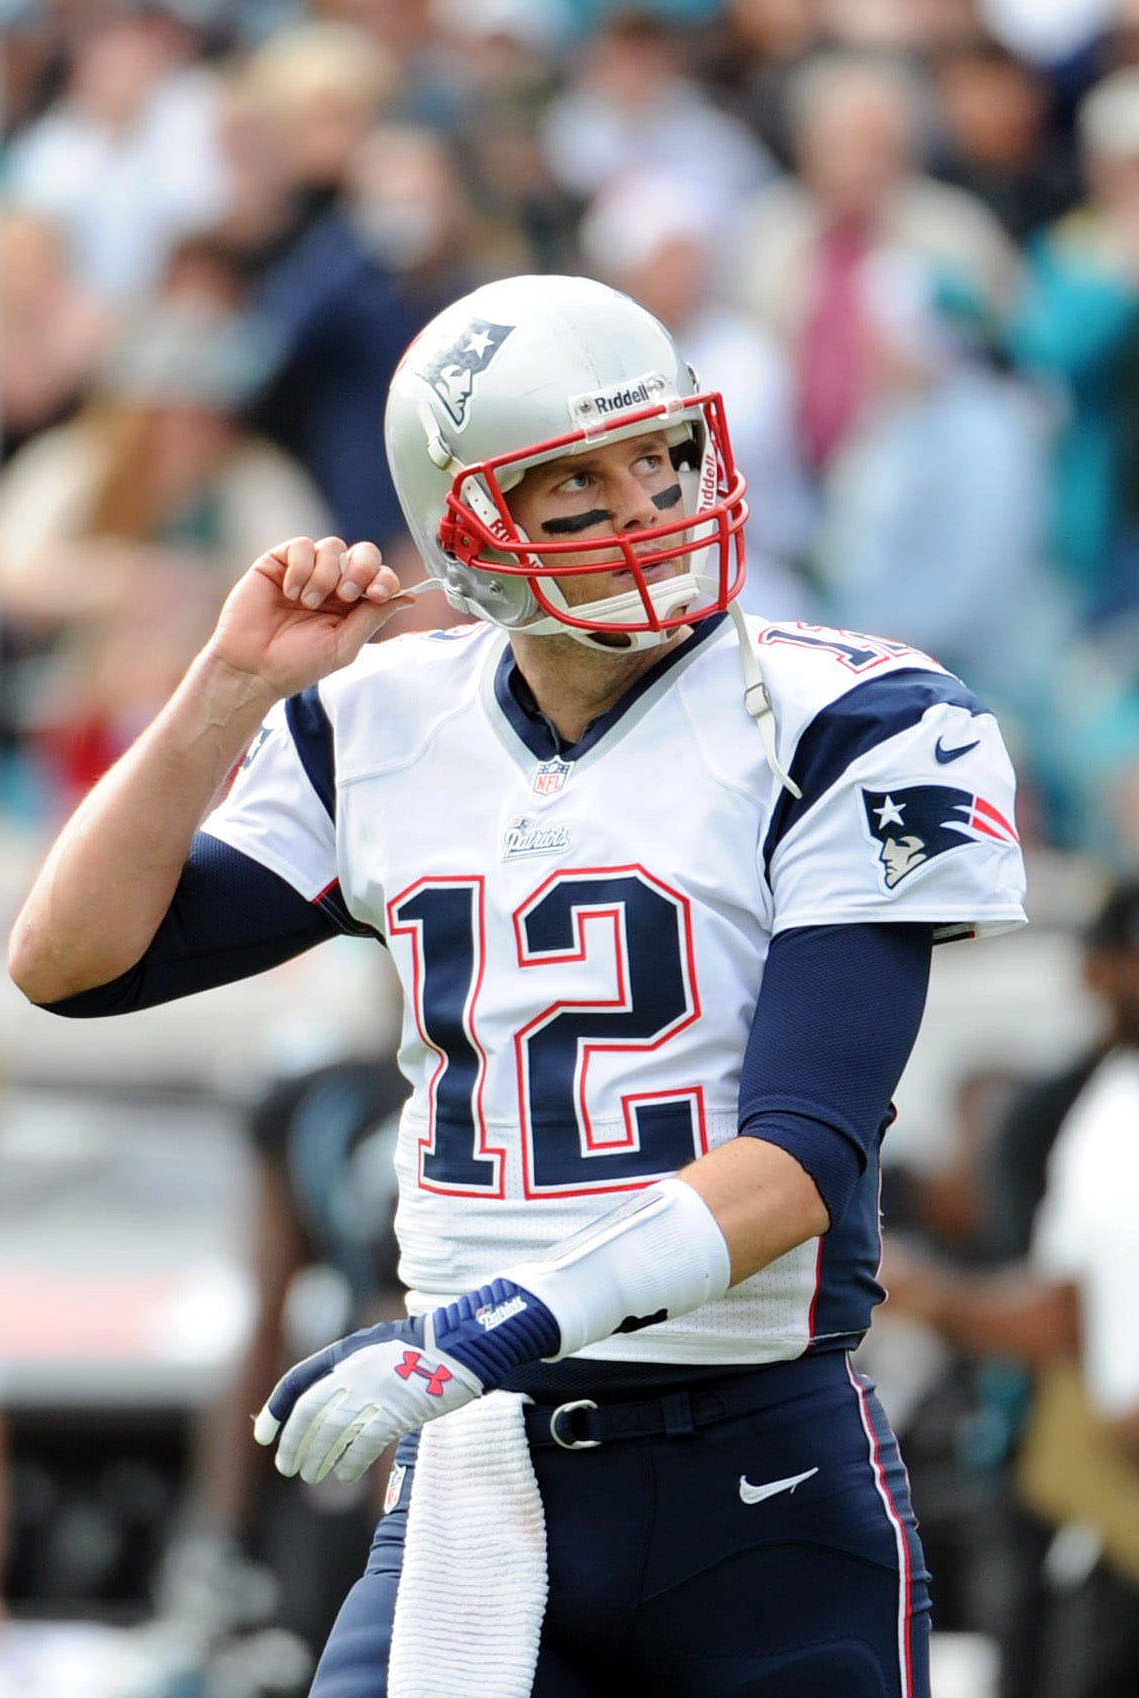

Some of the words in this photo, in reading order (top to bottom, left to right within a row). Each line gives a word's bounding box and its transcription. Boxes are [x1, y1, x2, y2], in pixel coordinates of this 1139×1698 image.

[594, 383, 650, 415] Riddell
[537, 774, 562, 792] NFL
[387, 863, 710, 1201] 12
